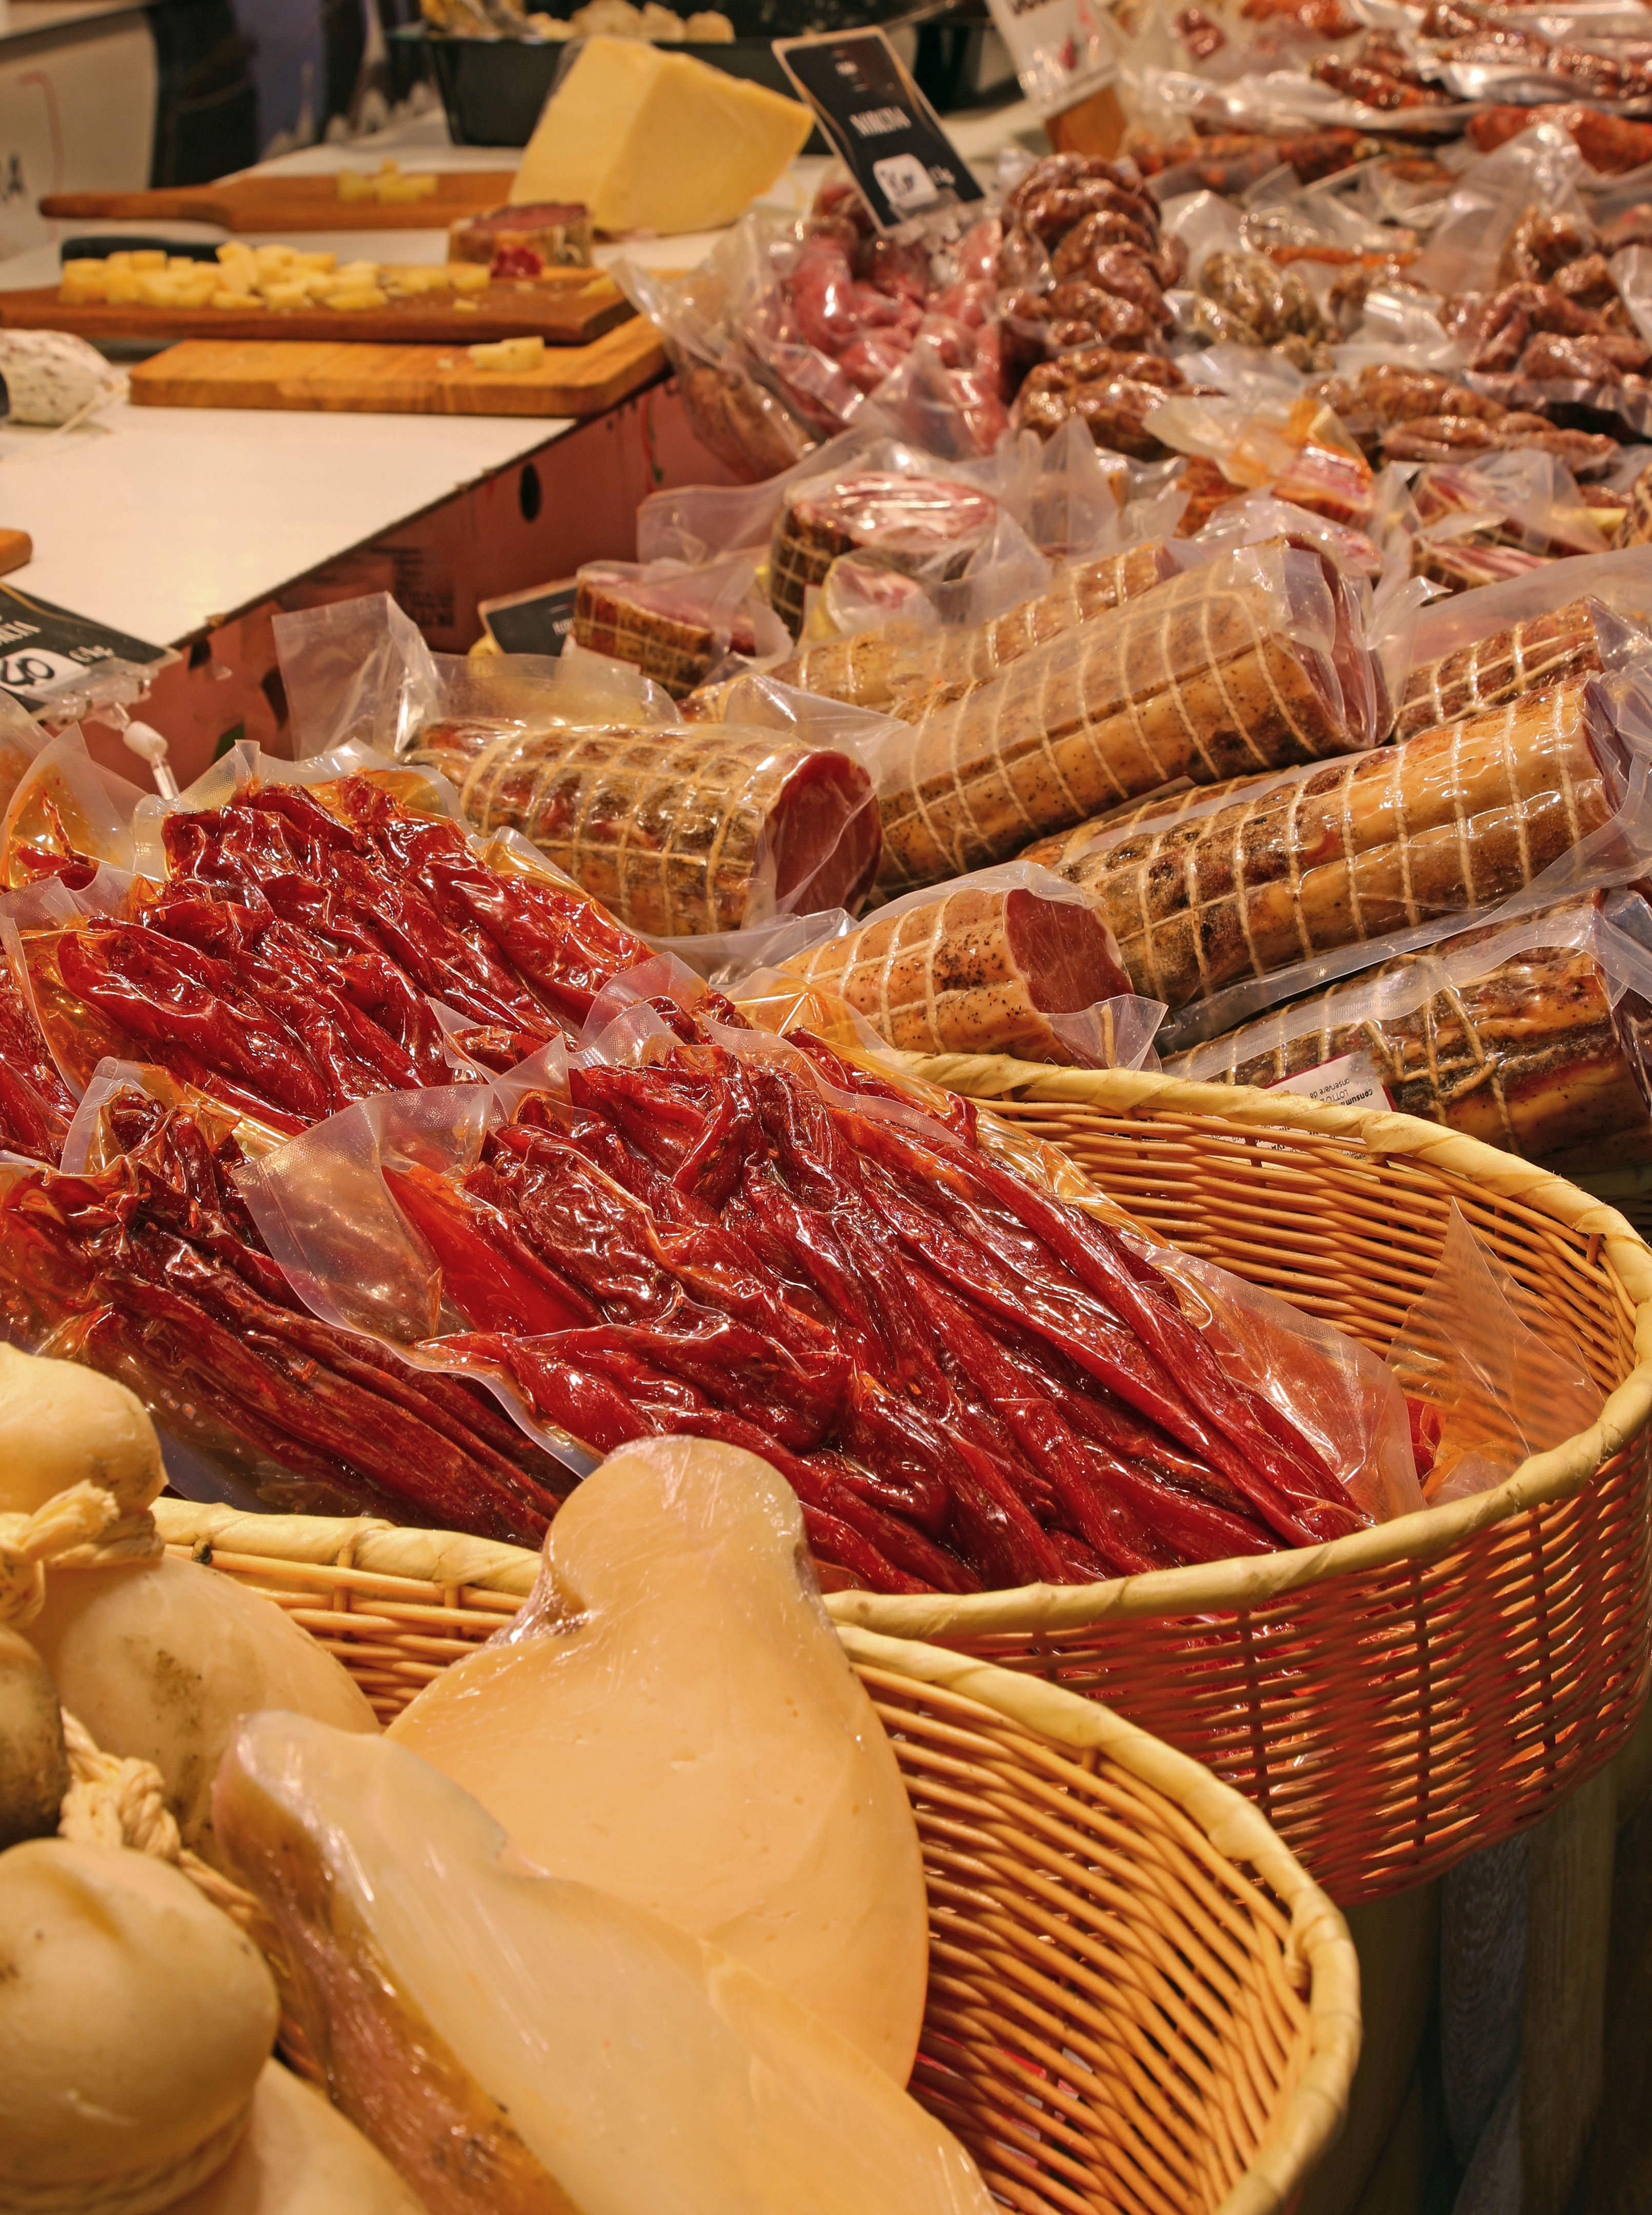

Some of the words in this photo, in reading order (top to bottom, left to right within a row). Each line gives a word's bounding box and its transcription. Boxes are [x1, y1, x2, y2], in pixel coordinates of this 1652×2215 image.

[1319, 1078, 1350, 1095] onservare
[1310, 1091, 1318, 1099] da
[1326, 1089, 1348, 1102] LOTTO
[1339, 1089, 1373, 1105] consuma
